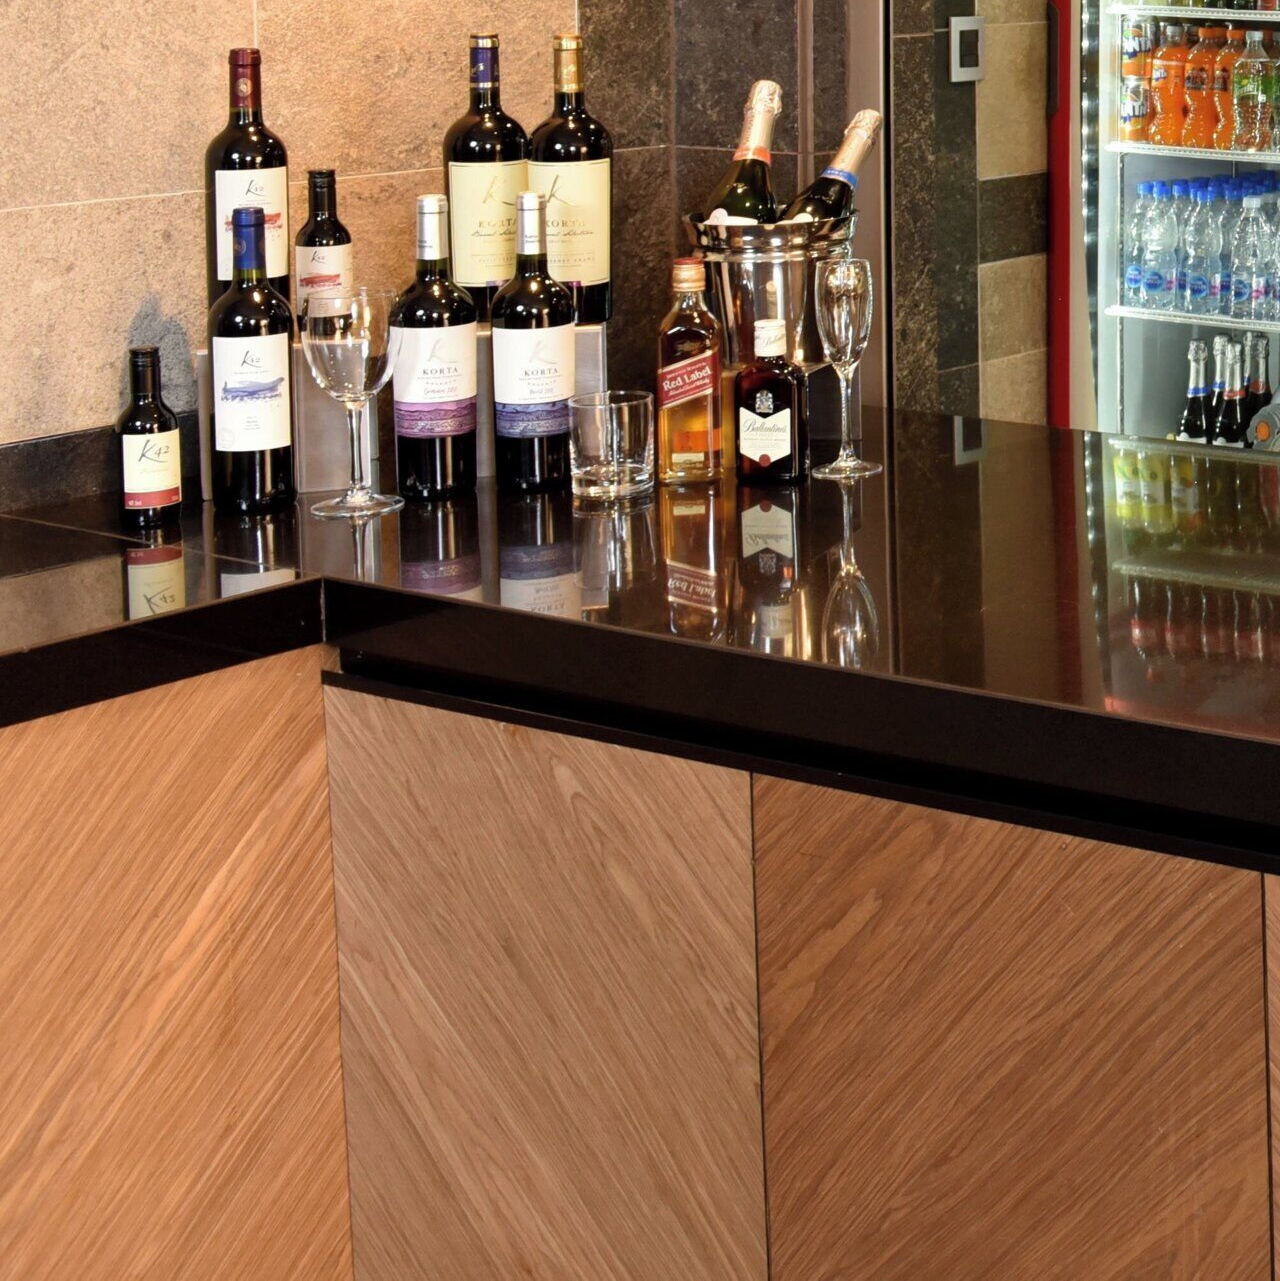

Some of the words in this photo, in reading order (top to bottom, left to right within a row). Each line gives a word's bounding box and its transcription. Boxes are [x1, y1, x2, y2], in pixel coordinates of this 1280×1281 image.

[423, 366, 458, 376] KORTA
[524, 367, 559, 378] KORTA
[662, 377, 683, 391] Red
[683, 366, 712, 383] Label
